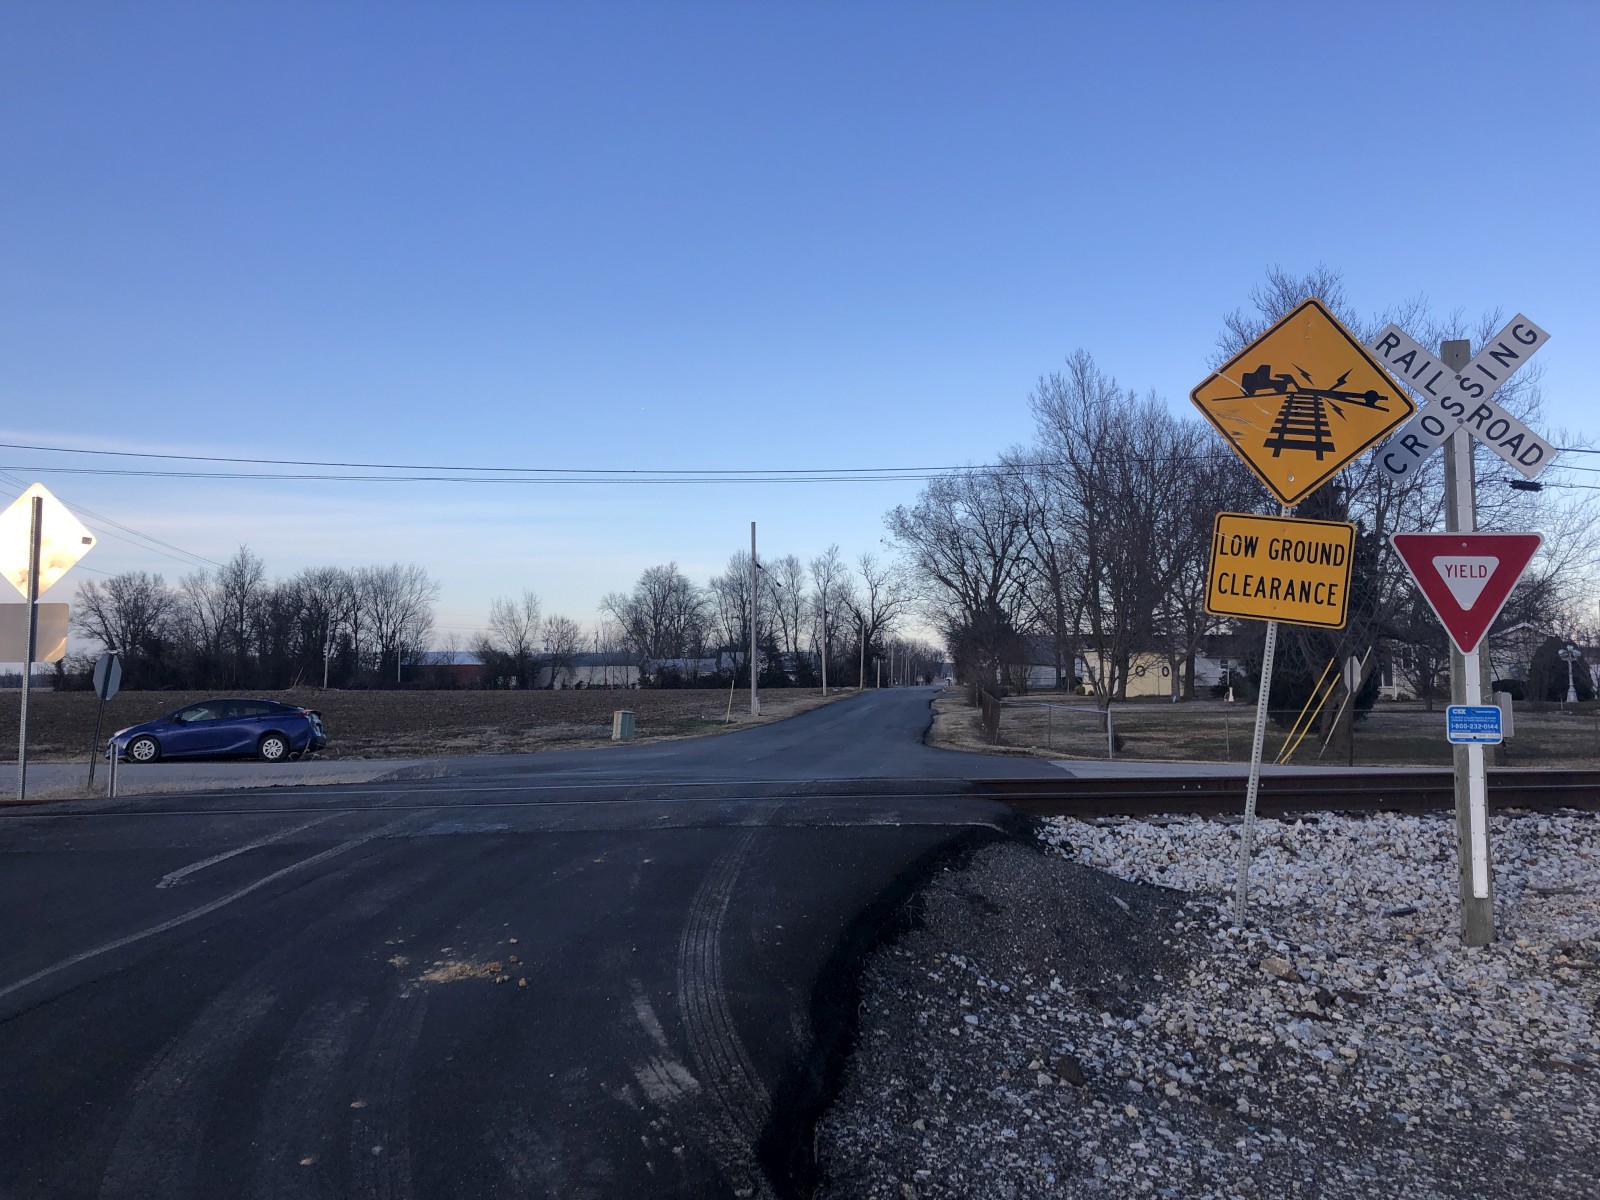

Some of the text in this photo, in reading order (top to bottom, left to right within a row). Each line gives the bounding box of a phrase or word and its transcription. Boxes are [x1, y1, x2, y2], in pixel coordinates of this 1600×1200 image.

[1375, 331, 1544, 467] RAIL ROAD
[1383, 324, 1538, 475] CROSSING
[1219, 533, 1345, 567] LOW GROUND
[1444, 564, 1488, 578] YIELD
[1217, 572, 1339, 607] CLEARANCE
